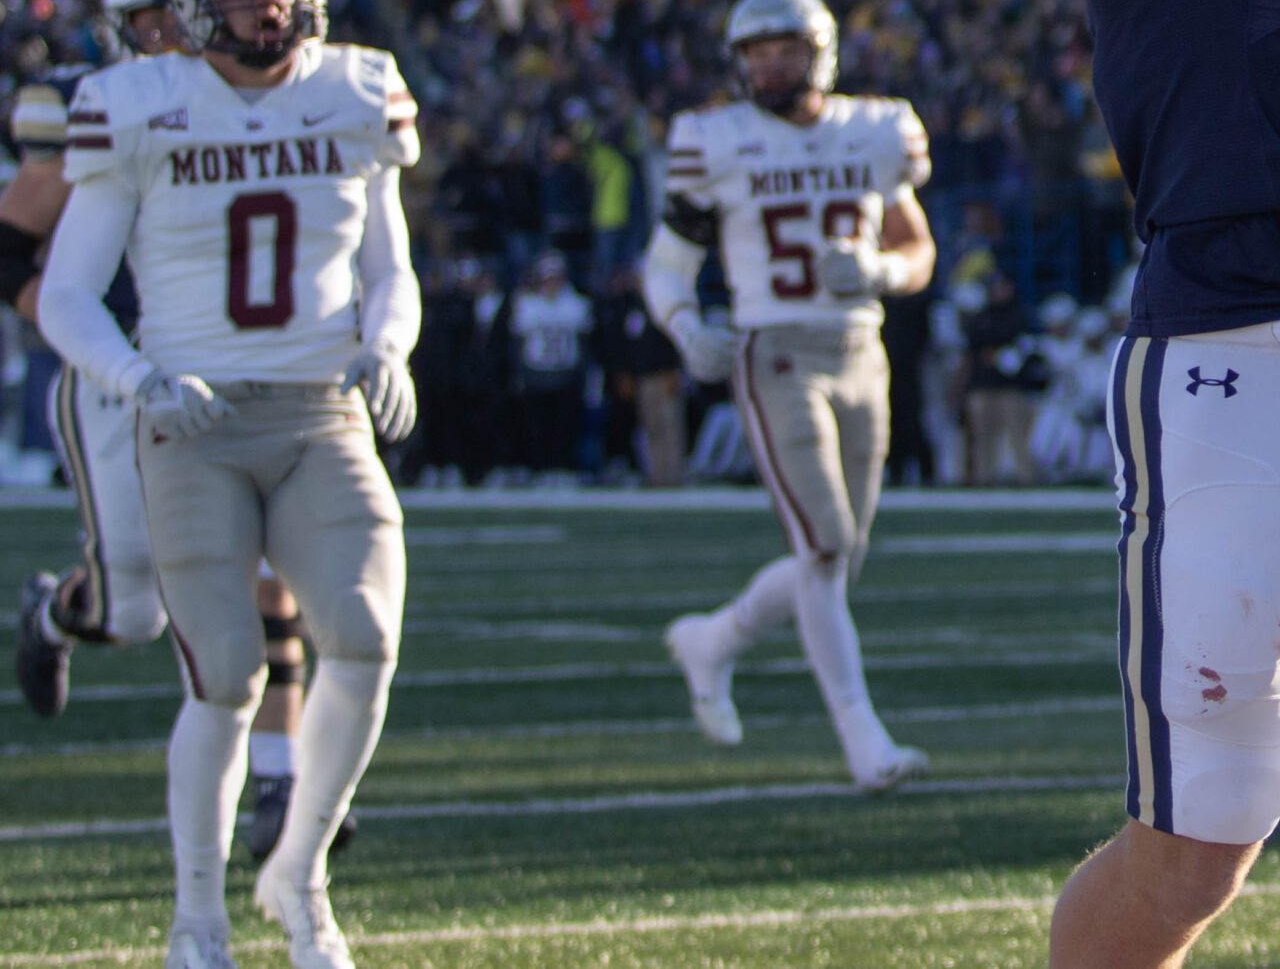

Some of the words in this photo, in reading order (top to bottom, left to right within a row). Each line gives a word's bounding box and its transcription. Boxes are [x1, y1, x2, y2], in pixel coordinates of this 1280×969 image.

[170, 137, 344, 186] MONTANA
[748, 161, 873, 198] MONTANA
[226, 191, 297, 328] 0
